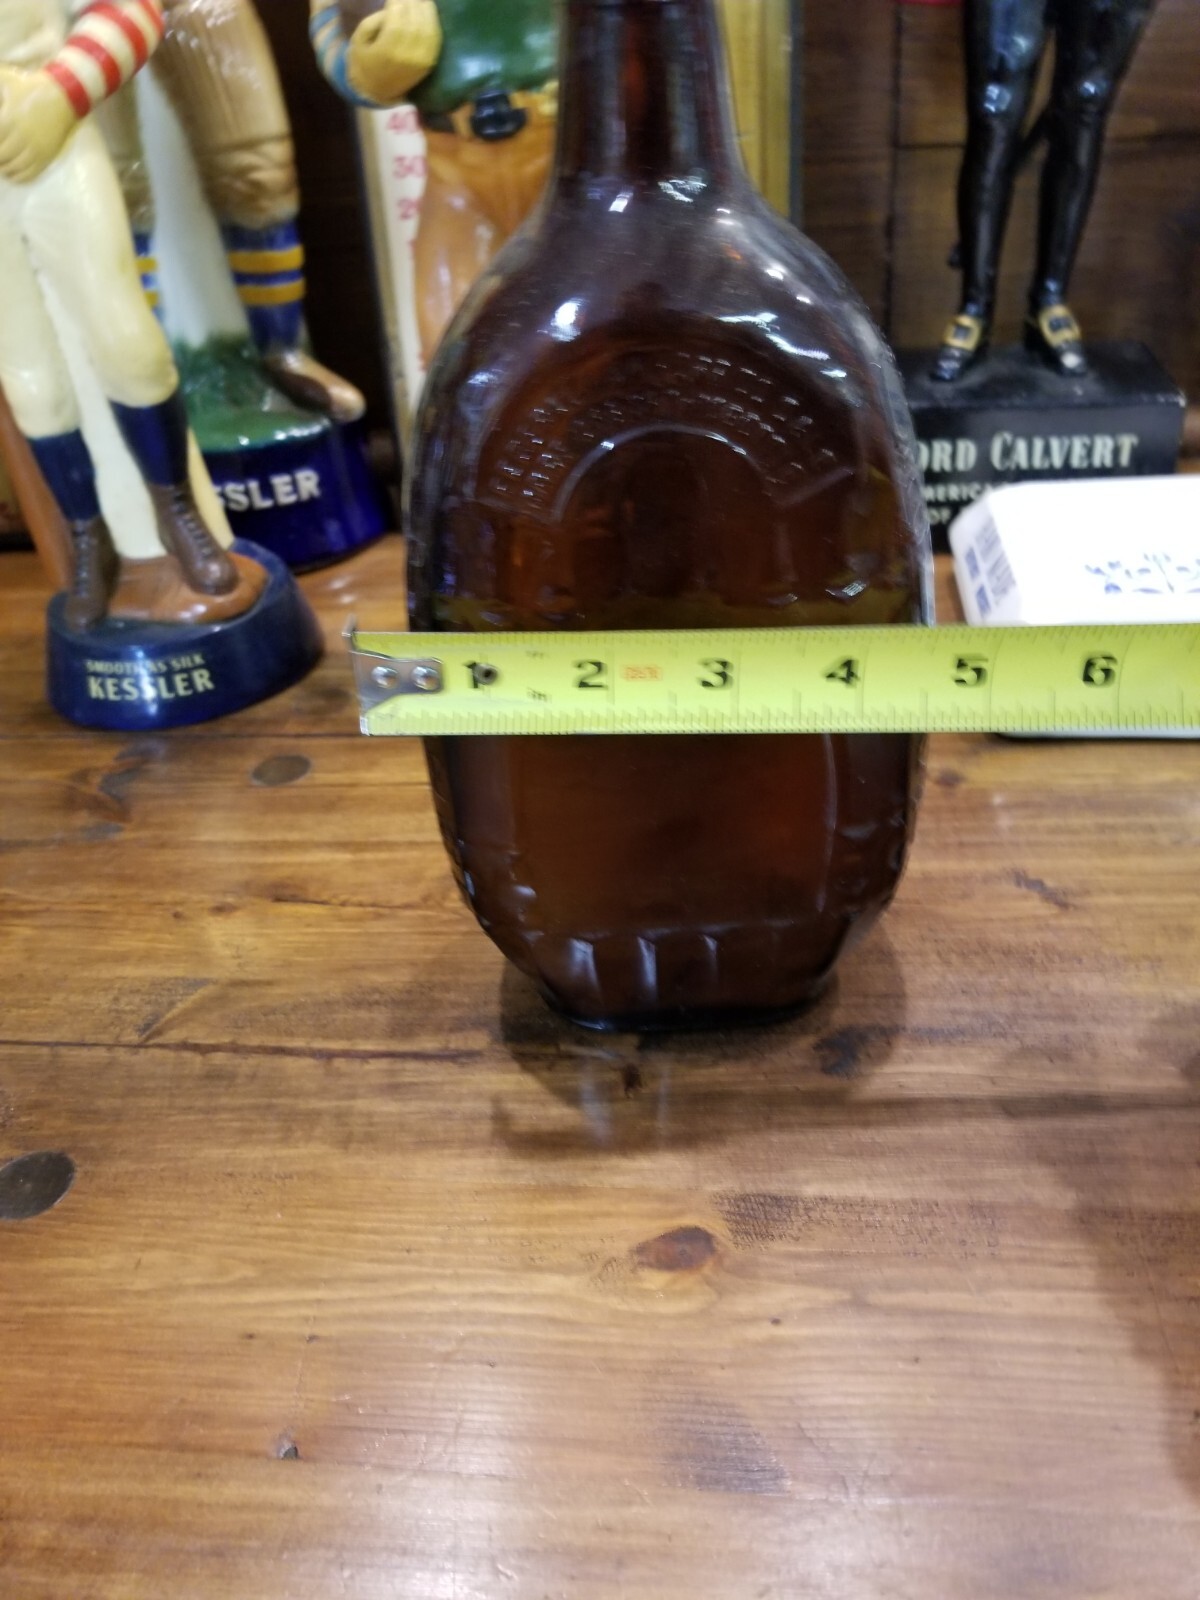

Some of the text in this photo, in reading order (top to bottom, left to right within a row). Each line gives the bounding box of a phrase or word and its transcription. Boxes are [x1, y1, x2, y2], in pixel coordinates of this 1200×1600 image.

[88, 668, 215, 701] KESSLER
[574, 659, 609, 690] 2
[698, 657, 734, 690] 3
[825, 655, 861, 688] 4
[951, 653, 989, 688] 5
[1080, 652, 1119, 688] 6
